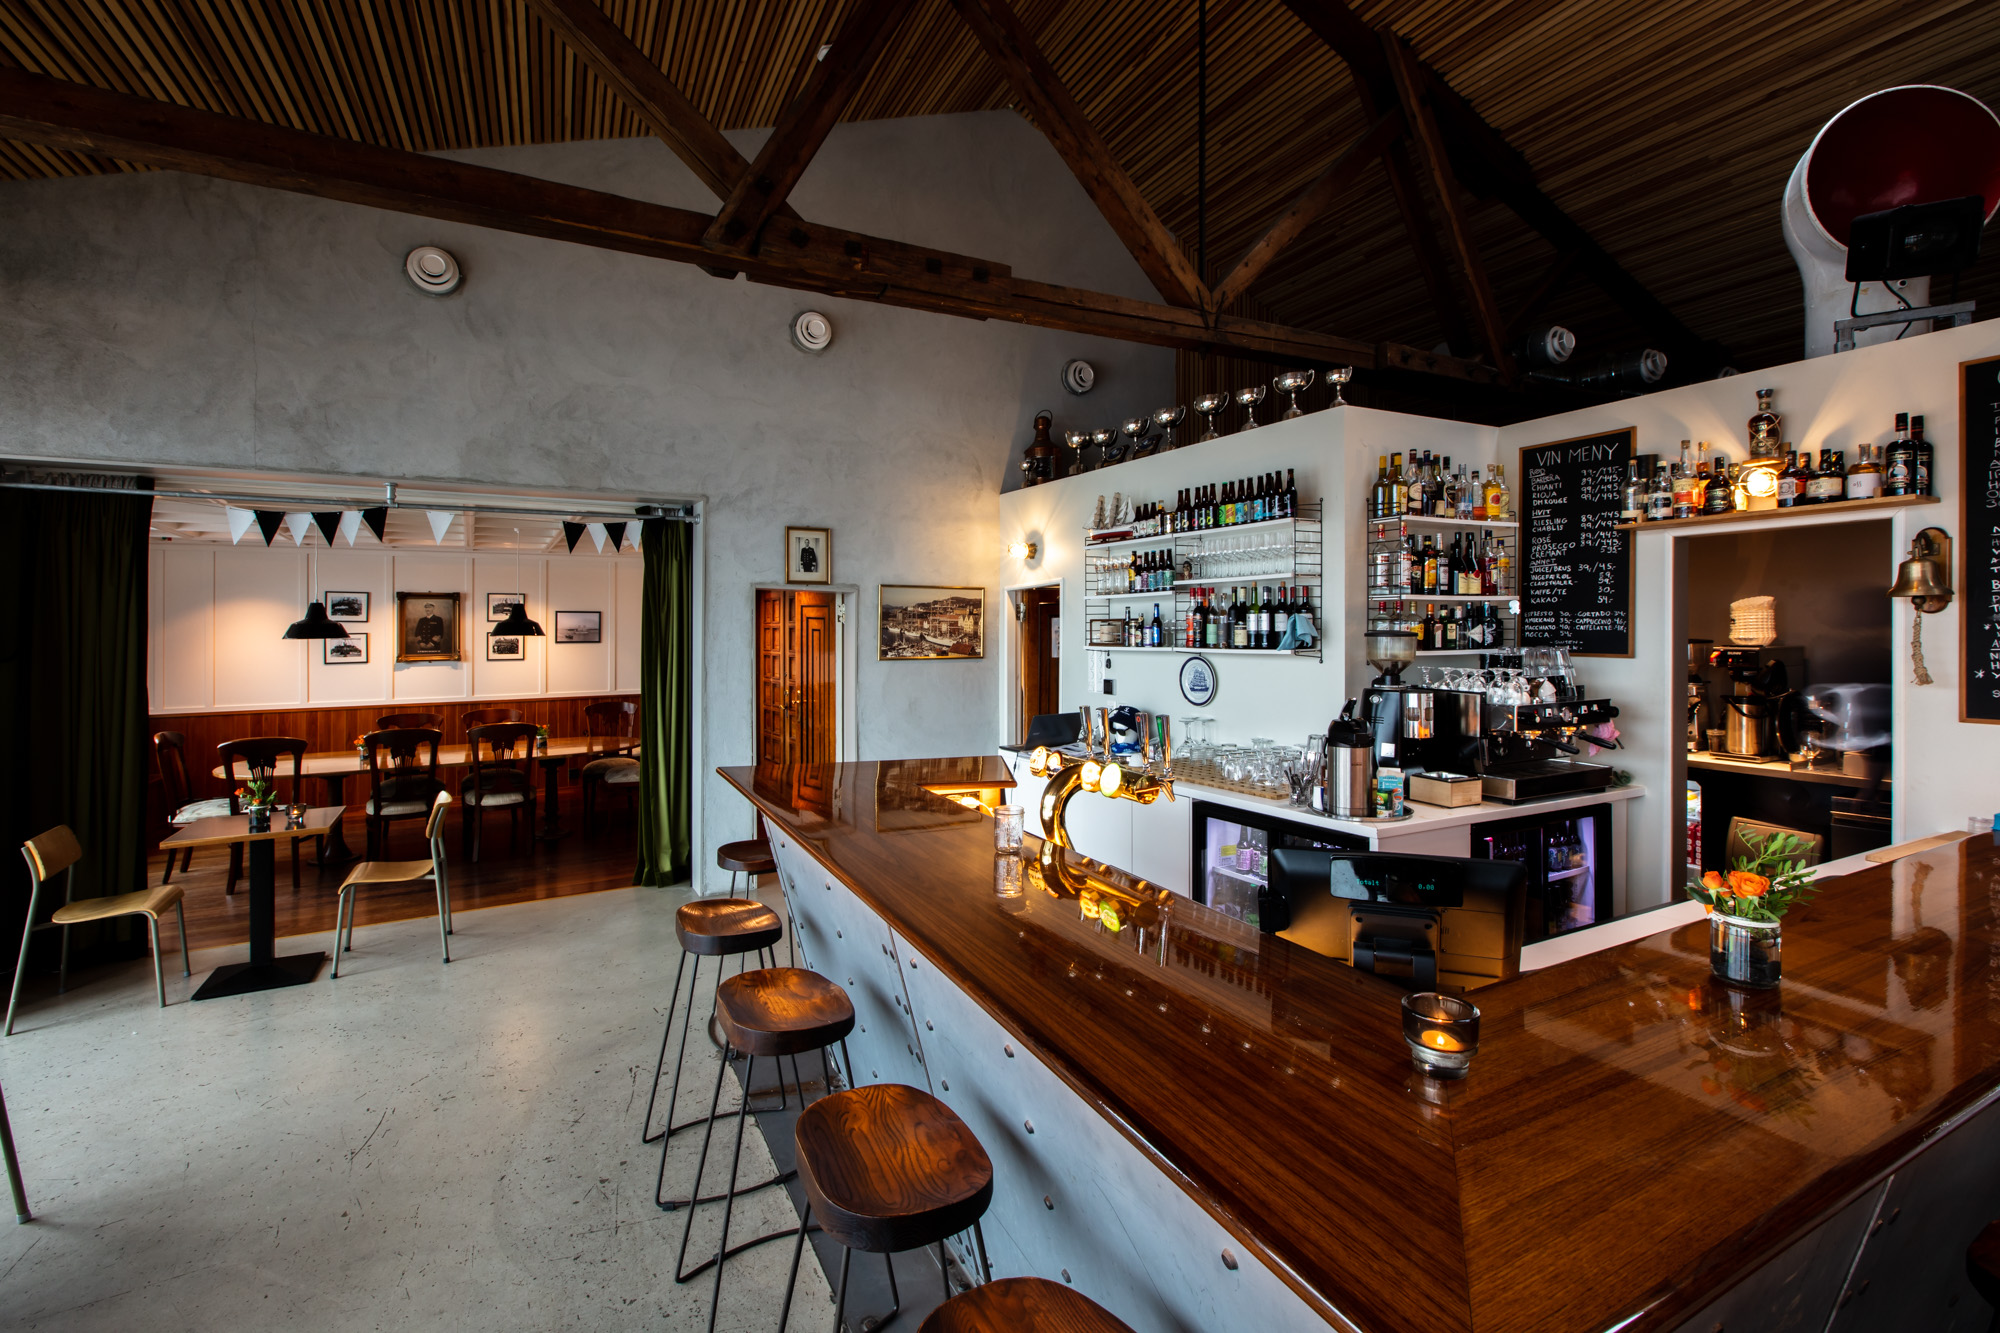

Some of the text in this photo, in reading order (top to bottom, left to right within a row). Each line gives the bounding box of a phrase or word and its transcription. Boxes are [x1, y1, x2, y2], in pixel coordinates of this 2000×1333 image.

[1536, 443, 1619, 467] VIN MENY
[1531, 482, 1562, 491] CHIANTI
[1532, 491, 1557, 499] RIOJA
[1532, 508, 1552, 518] HVIT
[1533, 518, 1568, 526] RIESLING
[1532, 524, 1564, 533] CHABLIS
[1532, 542, 1576, 552] PROSECCO
[1530, 597, 1558, 605] KAKAO
[1356, 878, 1380, 886] Totalt
